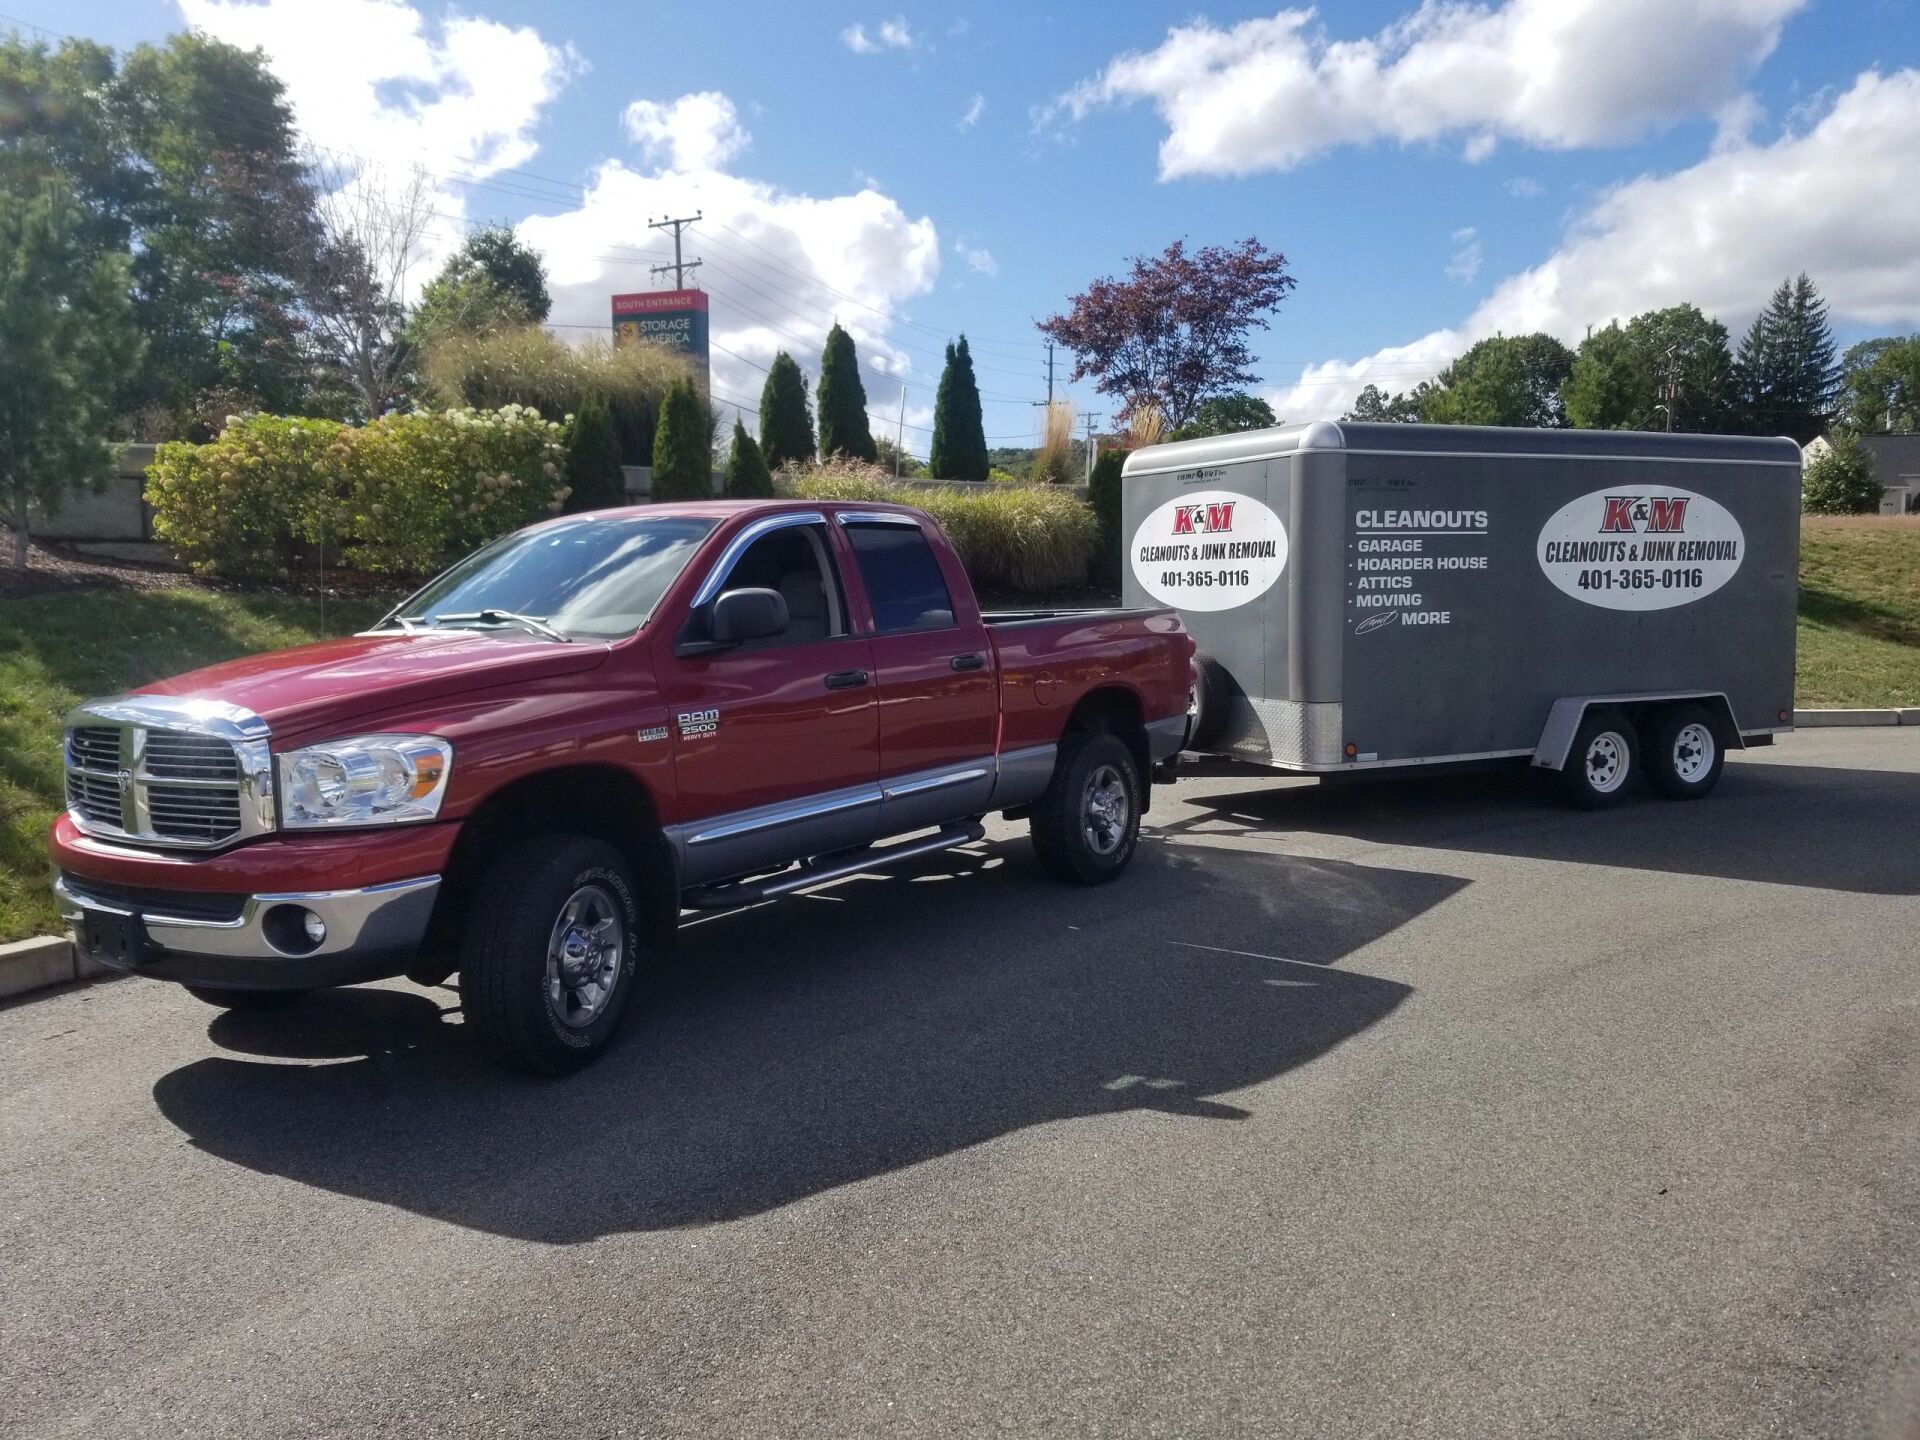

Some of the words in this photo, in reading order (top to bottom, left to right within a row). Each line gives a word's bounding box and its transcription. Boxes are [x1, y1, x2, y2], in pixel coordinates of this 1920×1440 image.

[616, 300, 644, 309] SOUTH
[646, 297, 692, 307] ENTRANCE
[641, 318, 690, 332] STORAGE
[641, 332, 690, 344] AMERICA
[1171, 501, 1236, 535] K&M
[1356, 510, 1488, 528] CLEANOUTS
[1598, 496, 1691, 533] K&M
[1140, 545, 1190, 562] CLEANOUTS
[1191, 546, 1198, 561] &
[1200, 543, 1226, 560] JUNK
[1228, 540, 1276, 559] REMOVAL
[1358, 540, 1422, 552] GARAGE
[1546, 541, 1626, 563] CLEANOUTS
[1628, 544, 1639, 562] &
[1640, 541, 1676, 562] JUNK
[1677, 540, 1737, 561] REMOVAL
[1357, 558, 1433, 571] HOARDER
[1437, 557, 1488, 569] HOUSE
[1160, 570, 1249, 587] 401-365-0116
[1358, 576, 1412, 589] ATTICS
[1578, 568, 1703, 590] 401-365-0116
[1356, 594, 1422, 607] MOVING
[1402, 612, 1450, 625] MORE
[678, 709, 720, 724] RAM
[682, 723, 717, 735] 2500
[683, 733, 701, 741] HEAVY
[703, 731, 717, 739] DUTY
